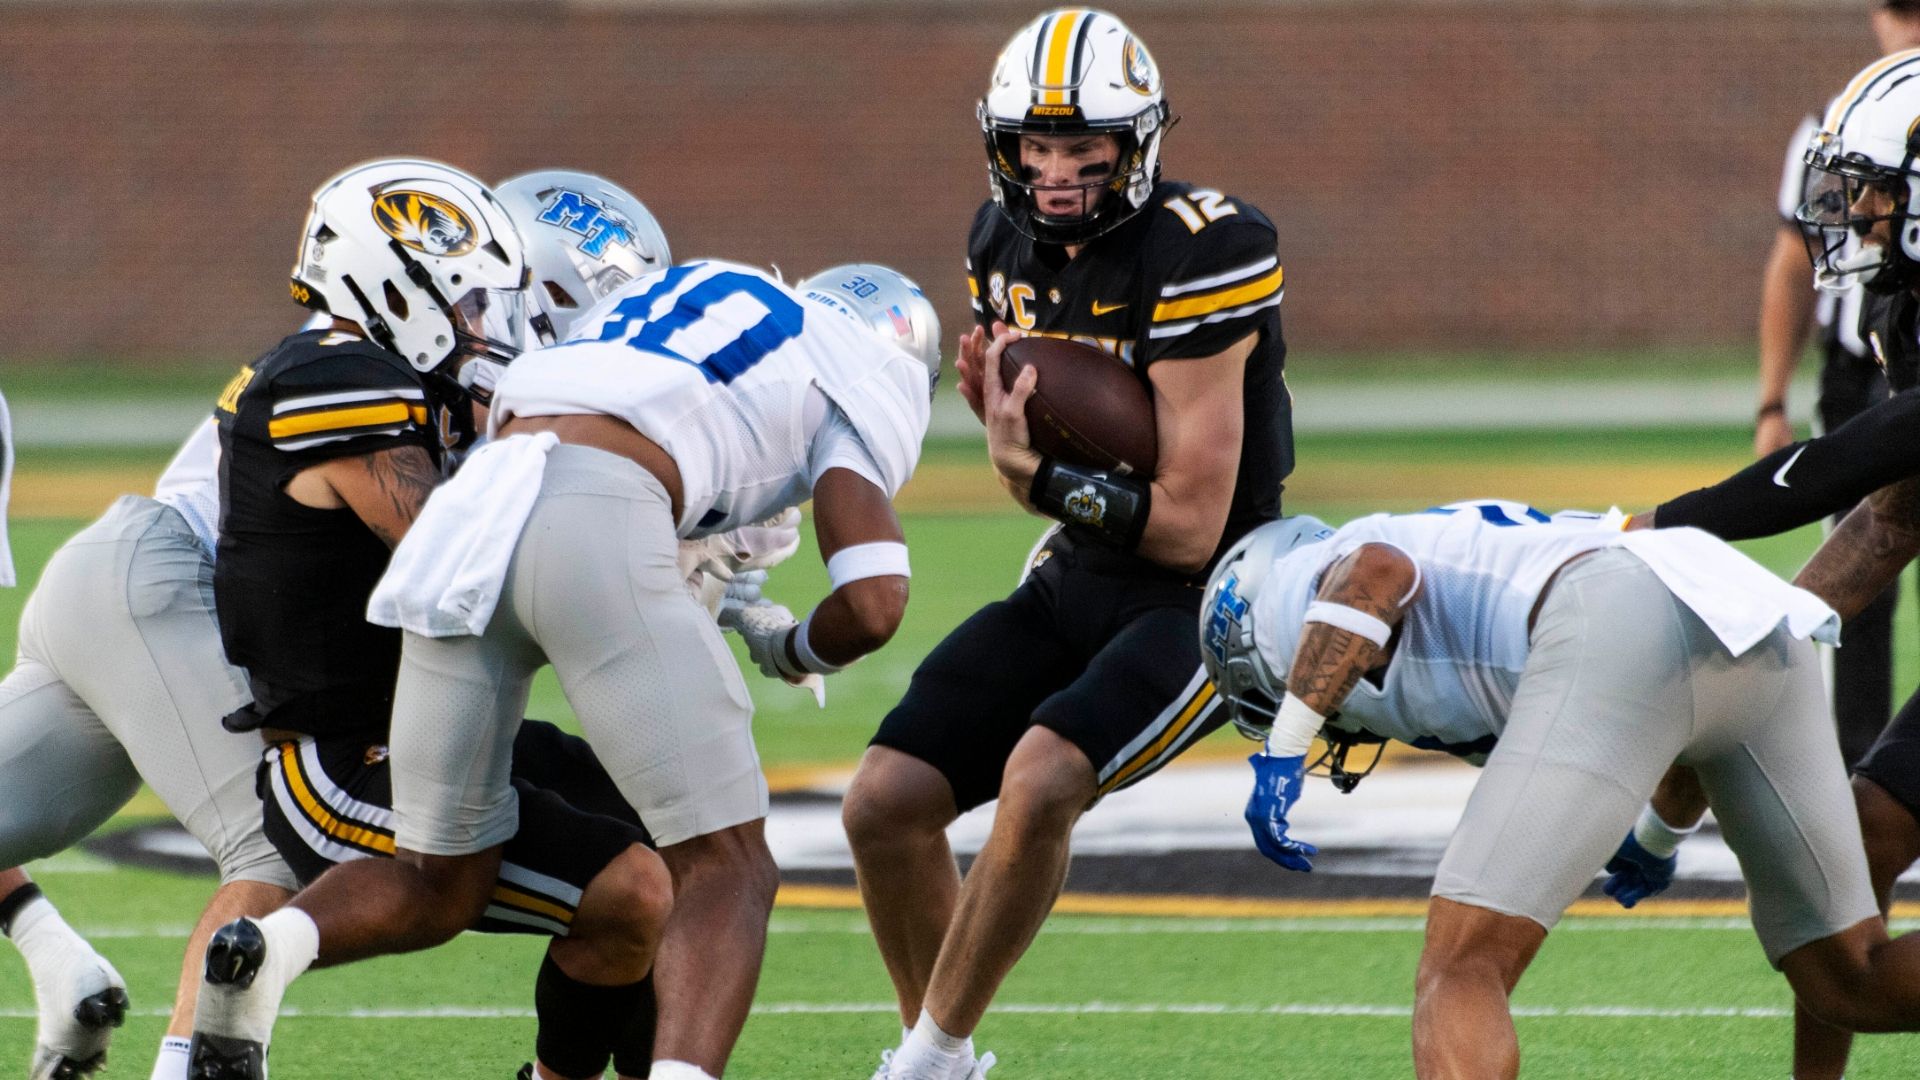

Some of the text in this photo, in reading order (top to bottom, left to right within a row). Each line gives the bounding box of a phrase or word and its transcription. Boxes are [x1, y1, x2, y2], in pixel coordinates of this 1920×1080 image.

[1032, 106, 1074, 116] MIZZOU
[536, 189, 635, 260] MT
[1163, 190, 1239, 234] 12
[841, 276, 879, 299] 30
[1008, 283, 1035, 330] C
